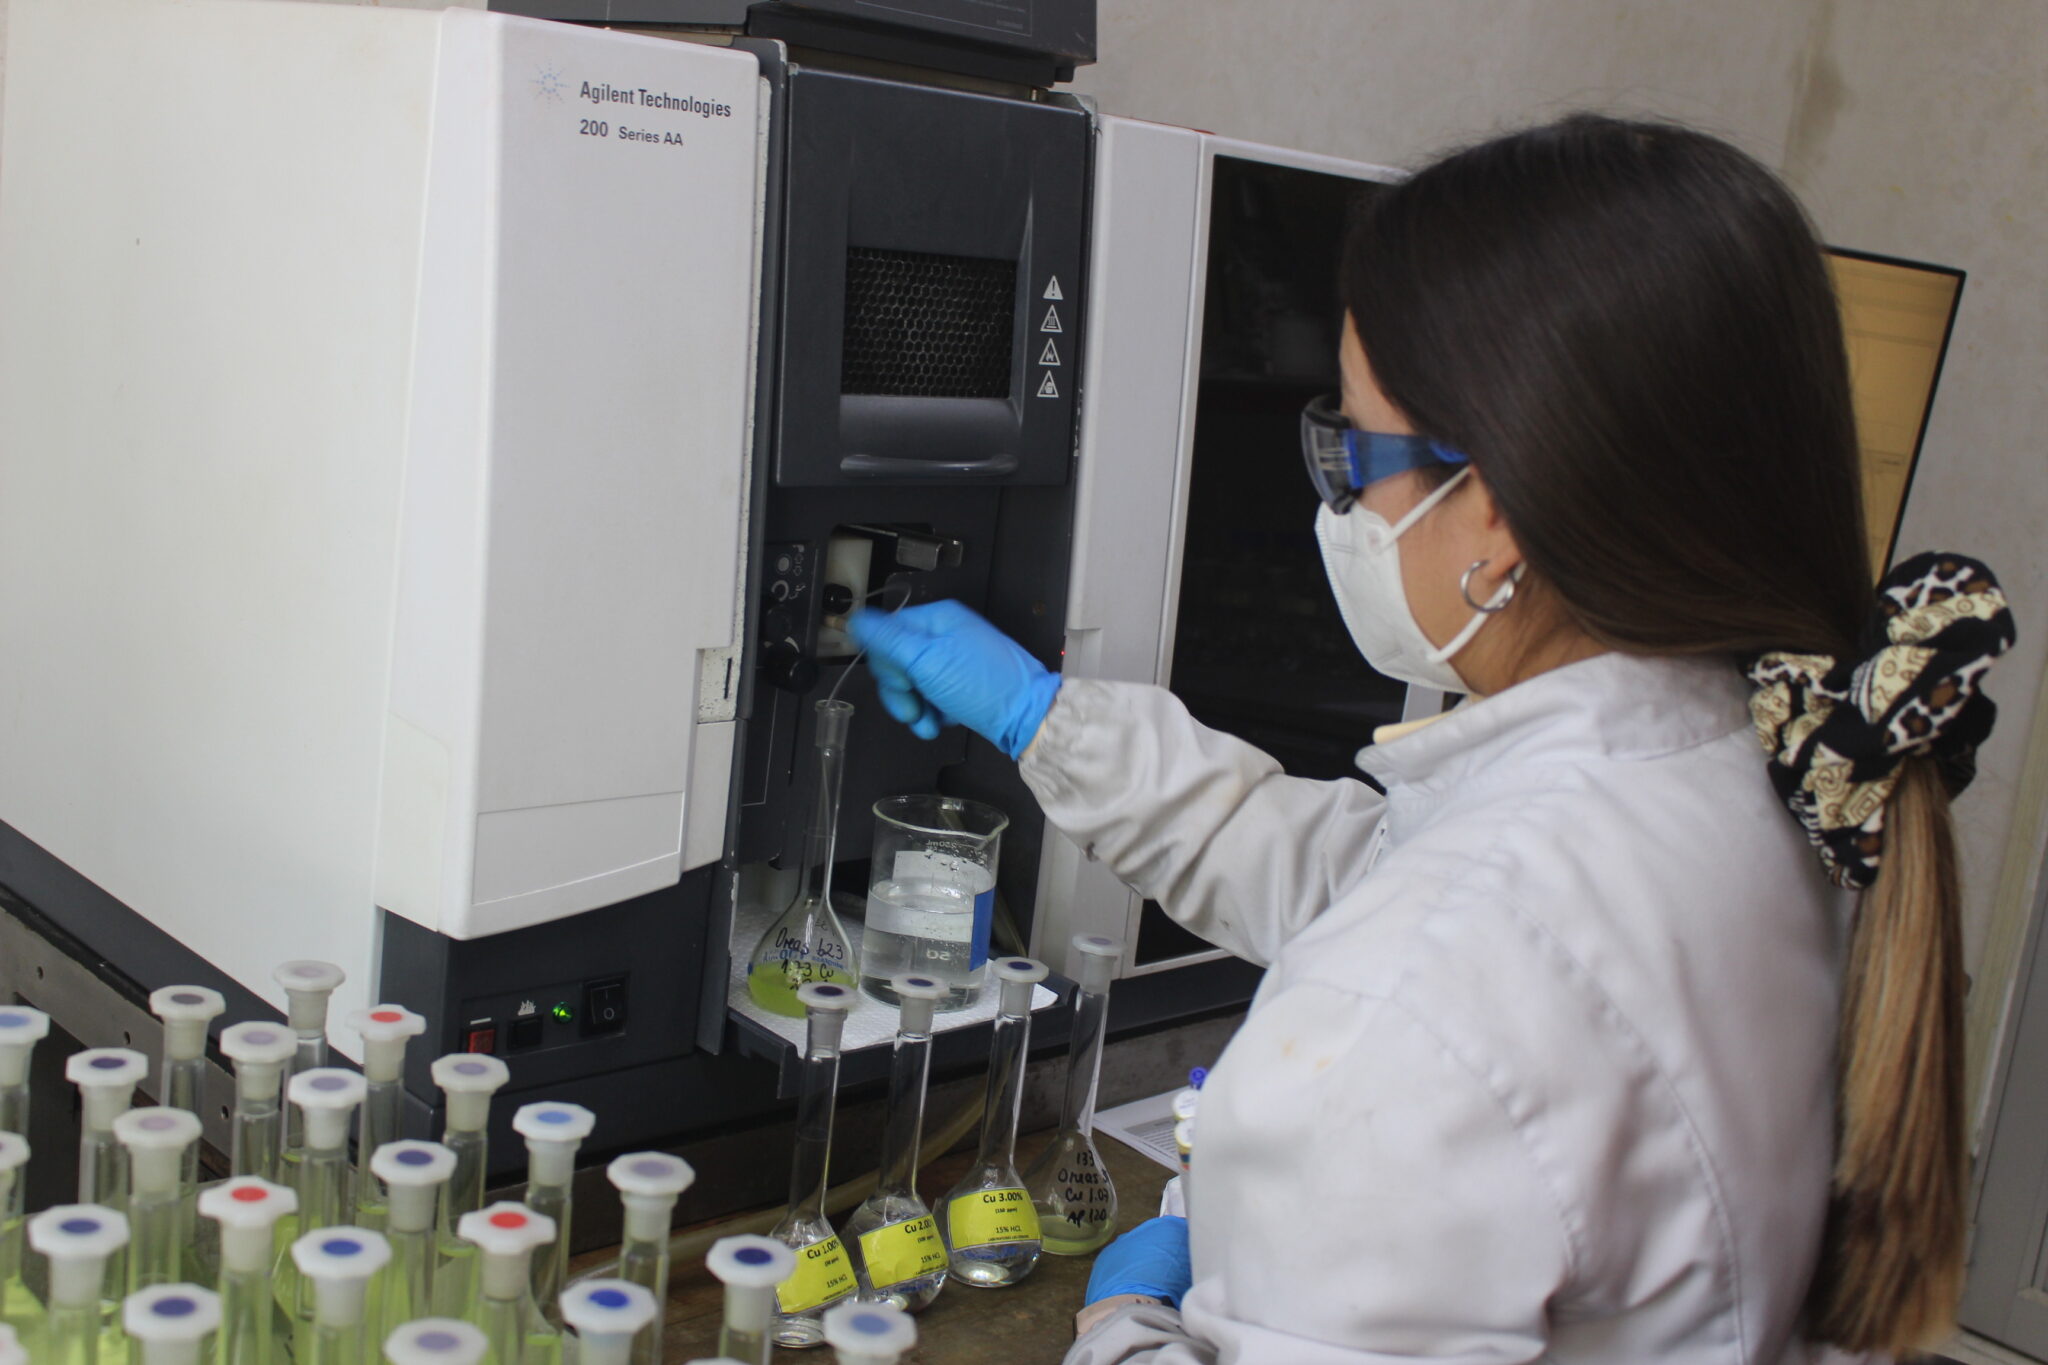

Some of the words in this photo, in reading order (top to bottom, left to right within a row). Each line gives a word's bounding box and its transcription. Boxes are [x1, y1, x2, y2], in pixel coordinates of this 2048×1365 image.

[579, 81, 635, 104] Agilent
[638, 88, 732, 118] Technologies
[579, 119, 609, 137] 200
[618, 126, 660, 143] Series
[664, 132, 684, 146] AA
[983, 1194, 996, 1203] Cu
[999, 1192, 1023, 1202] 3.00%
[1065, 1187, 1083, 1202] Cu
[904, 1224, 917, 1234] Cu
[806, 1249, 821, 1259] Cu
